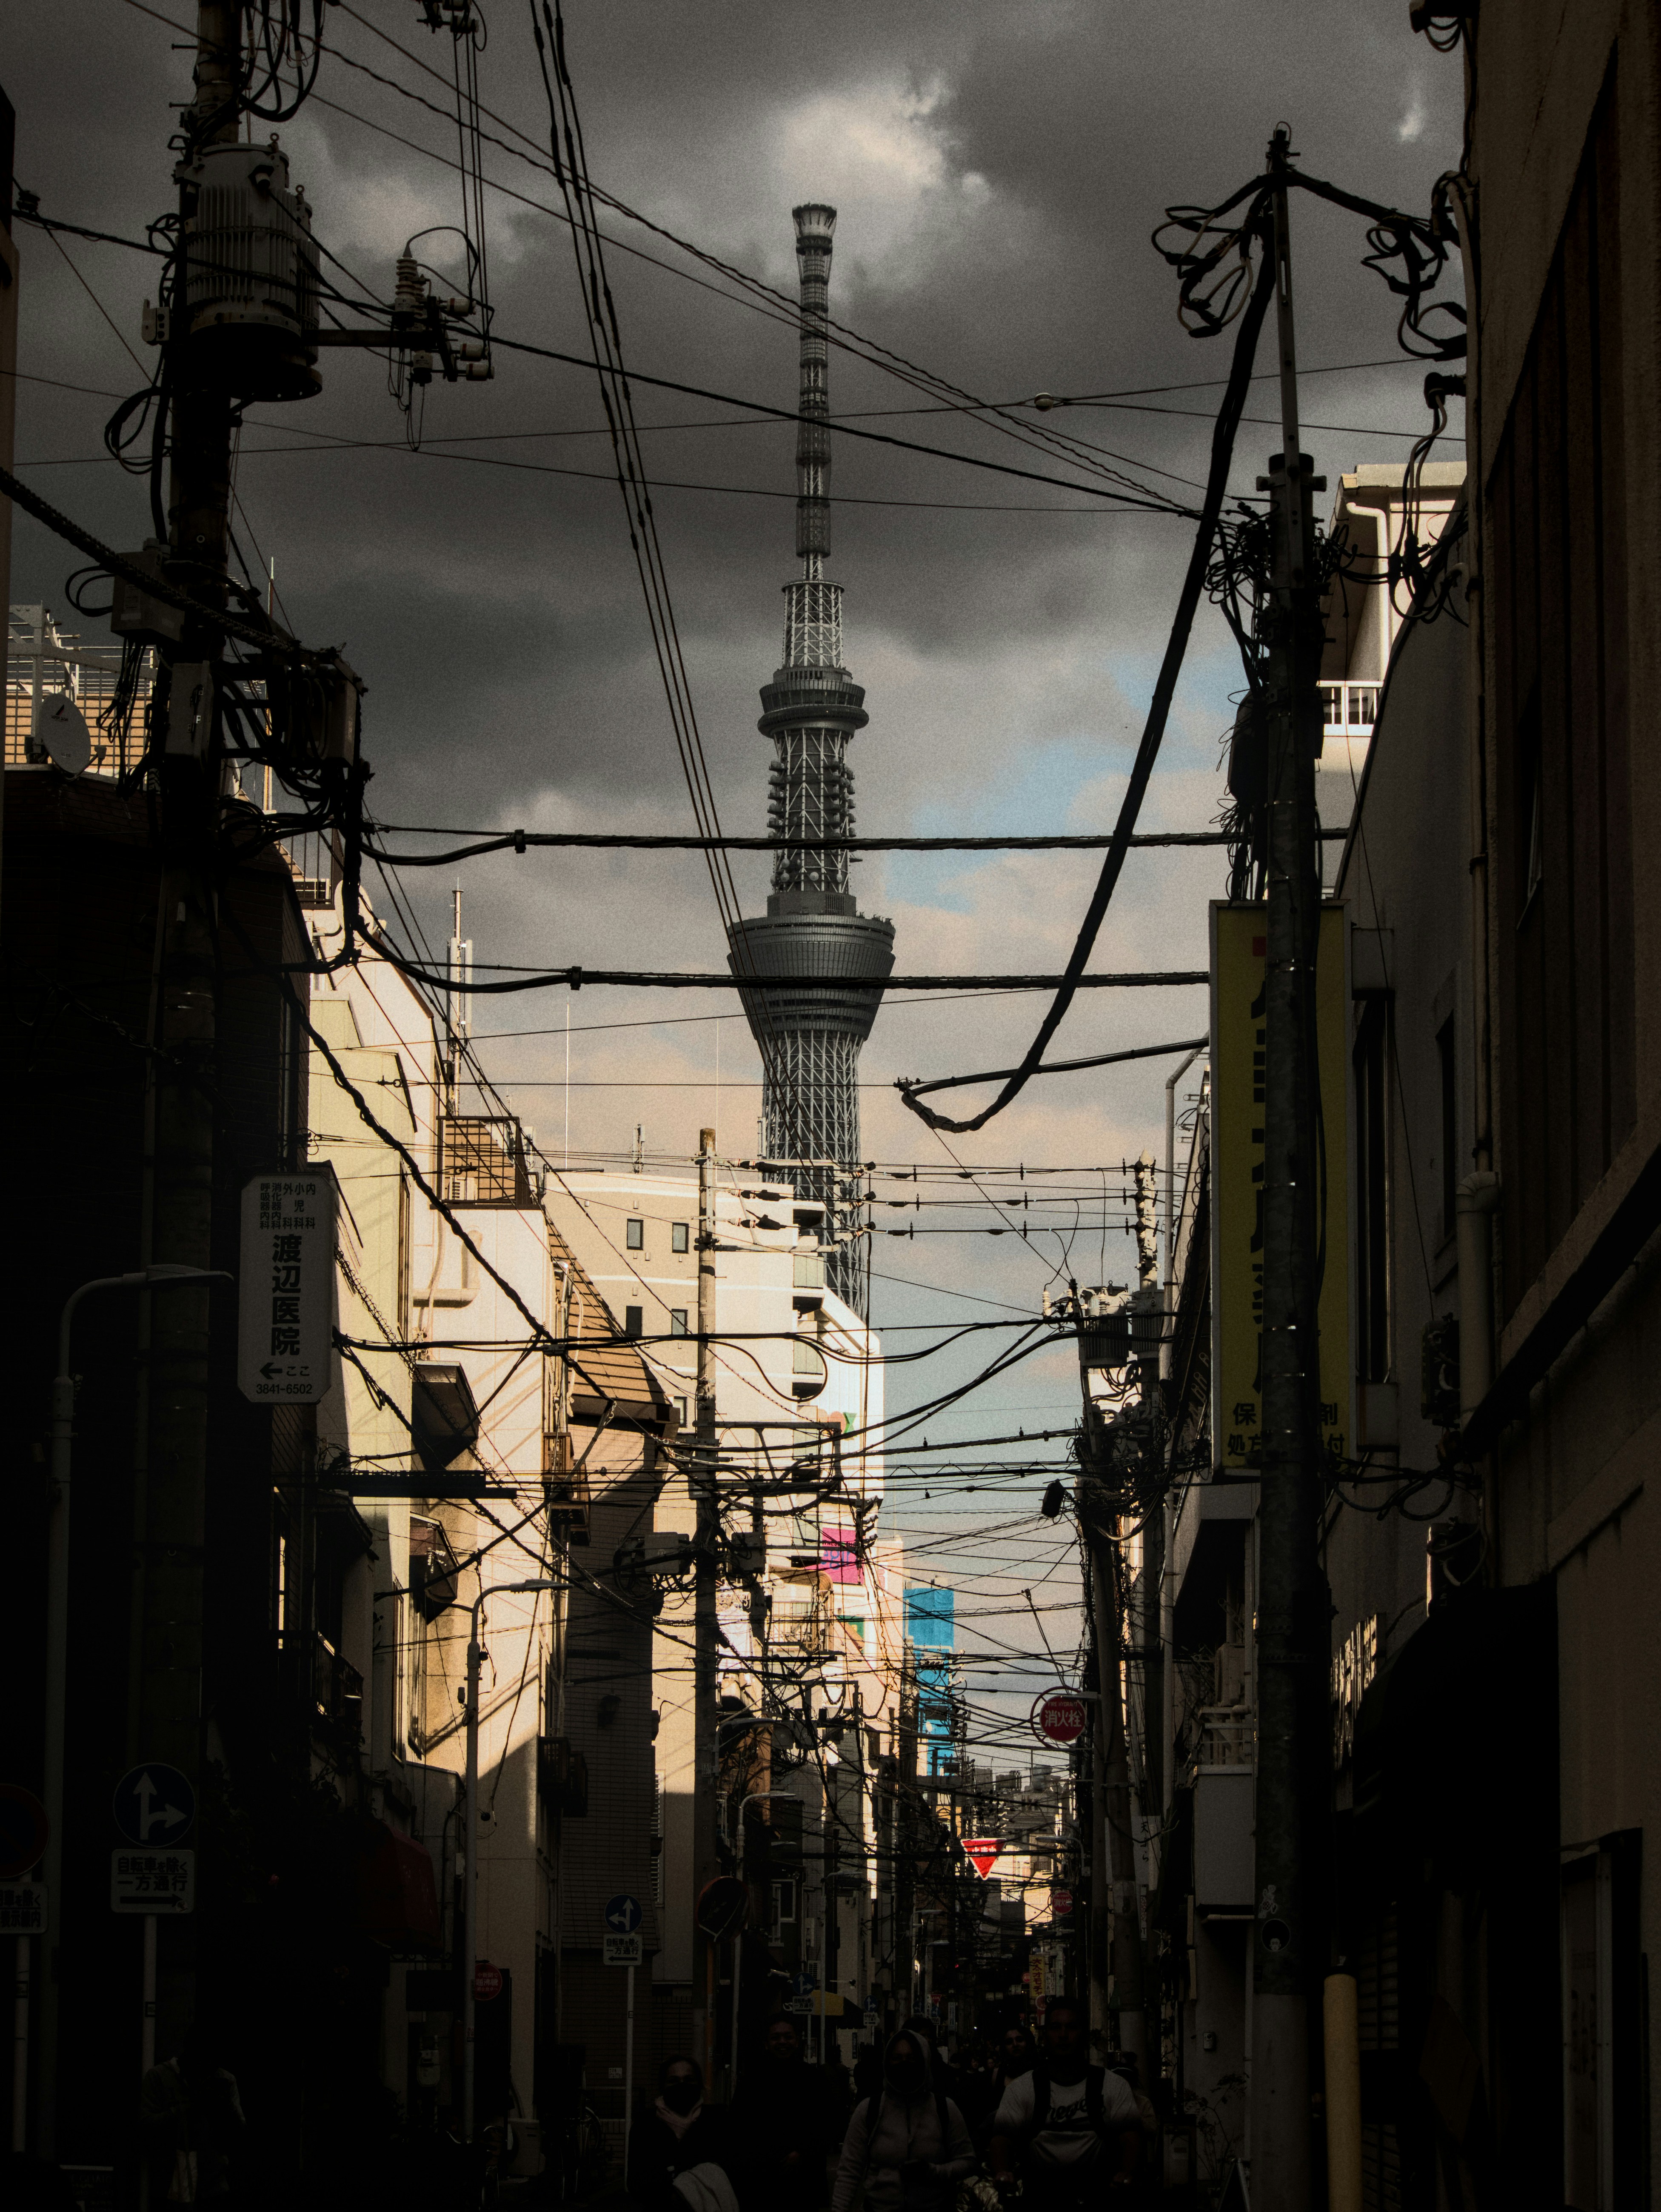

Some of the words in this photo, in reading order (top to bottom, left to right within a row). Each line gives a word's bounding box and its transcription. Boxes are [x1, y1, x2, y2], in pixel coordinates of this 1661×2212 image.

[260, 1183, 270, 1230] 呼吸器内科
[271, 1183, 282, 1229] 消化器内科
[283, 1183, 293, 1229] 外科
[294, 1183, 304, 1229] 小児科
[305, 1183, 316, 1229] 内科
[271, 1234, 302, 1356] 渡辺医院
[286, 1366, 310, 1377] ここ
[256, 1384, 312, 1395] 3841-6502
[1233, 1403, 1338, 1425] 保剤
[1045, 1709, 1082, 1727] 消火栓
[117, 1856, 187, 1874] 自転車を除く
[117, 1875, 187, 1892] 一方通行
[0, 1889, 41, 1906] 車を除く
[606, 1938, 639, 1946] 自転車を除く
